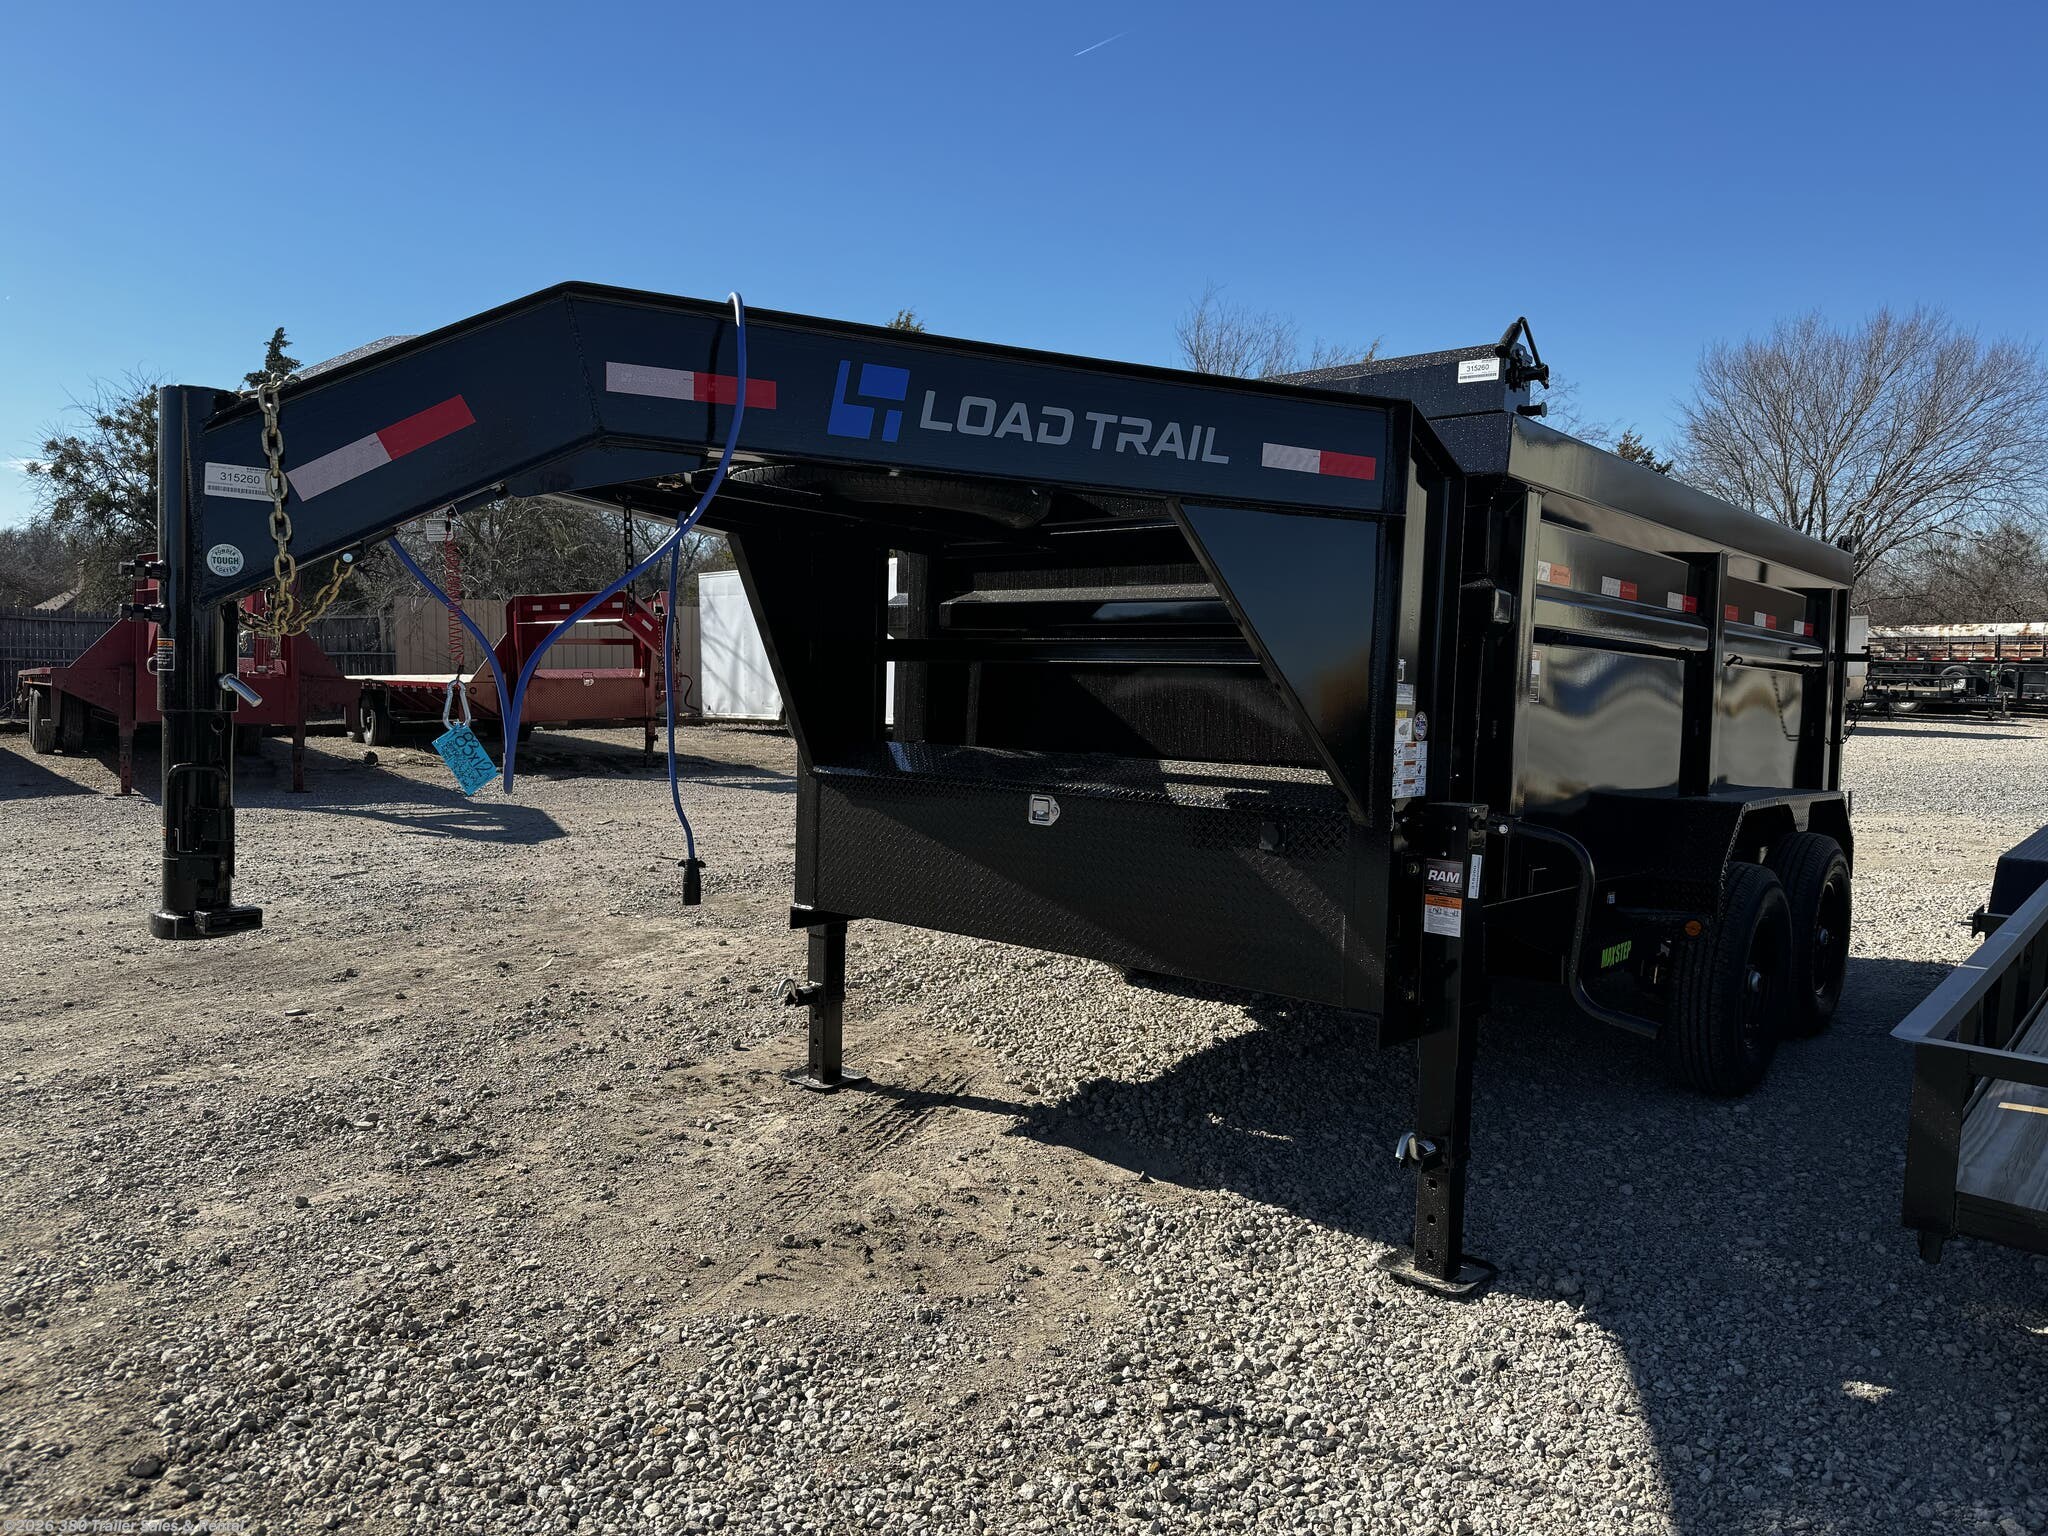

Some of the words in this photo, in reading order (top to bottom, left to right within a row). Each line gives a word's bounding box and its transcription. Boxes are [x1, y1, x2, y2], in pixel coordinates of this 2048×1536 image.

[1466, 364, 1490, 373] 315260
[919, 389, 1075, 446] LOAD
[1085, 411, 1231, 465] TRAIL
[220, 472, 261, 485] 315260
[212, 556, 239, 565] TOUGH
[1427, 869, 1460, 884] RAM
